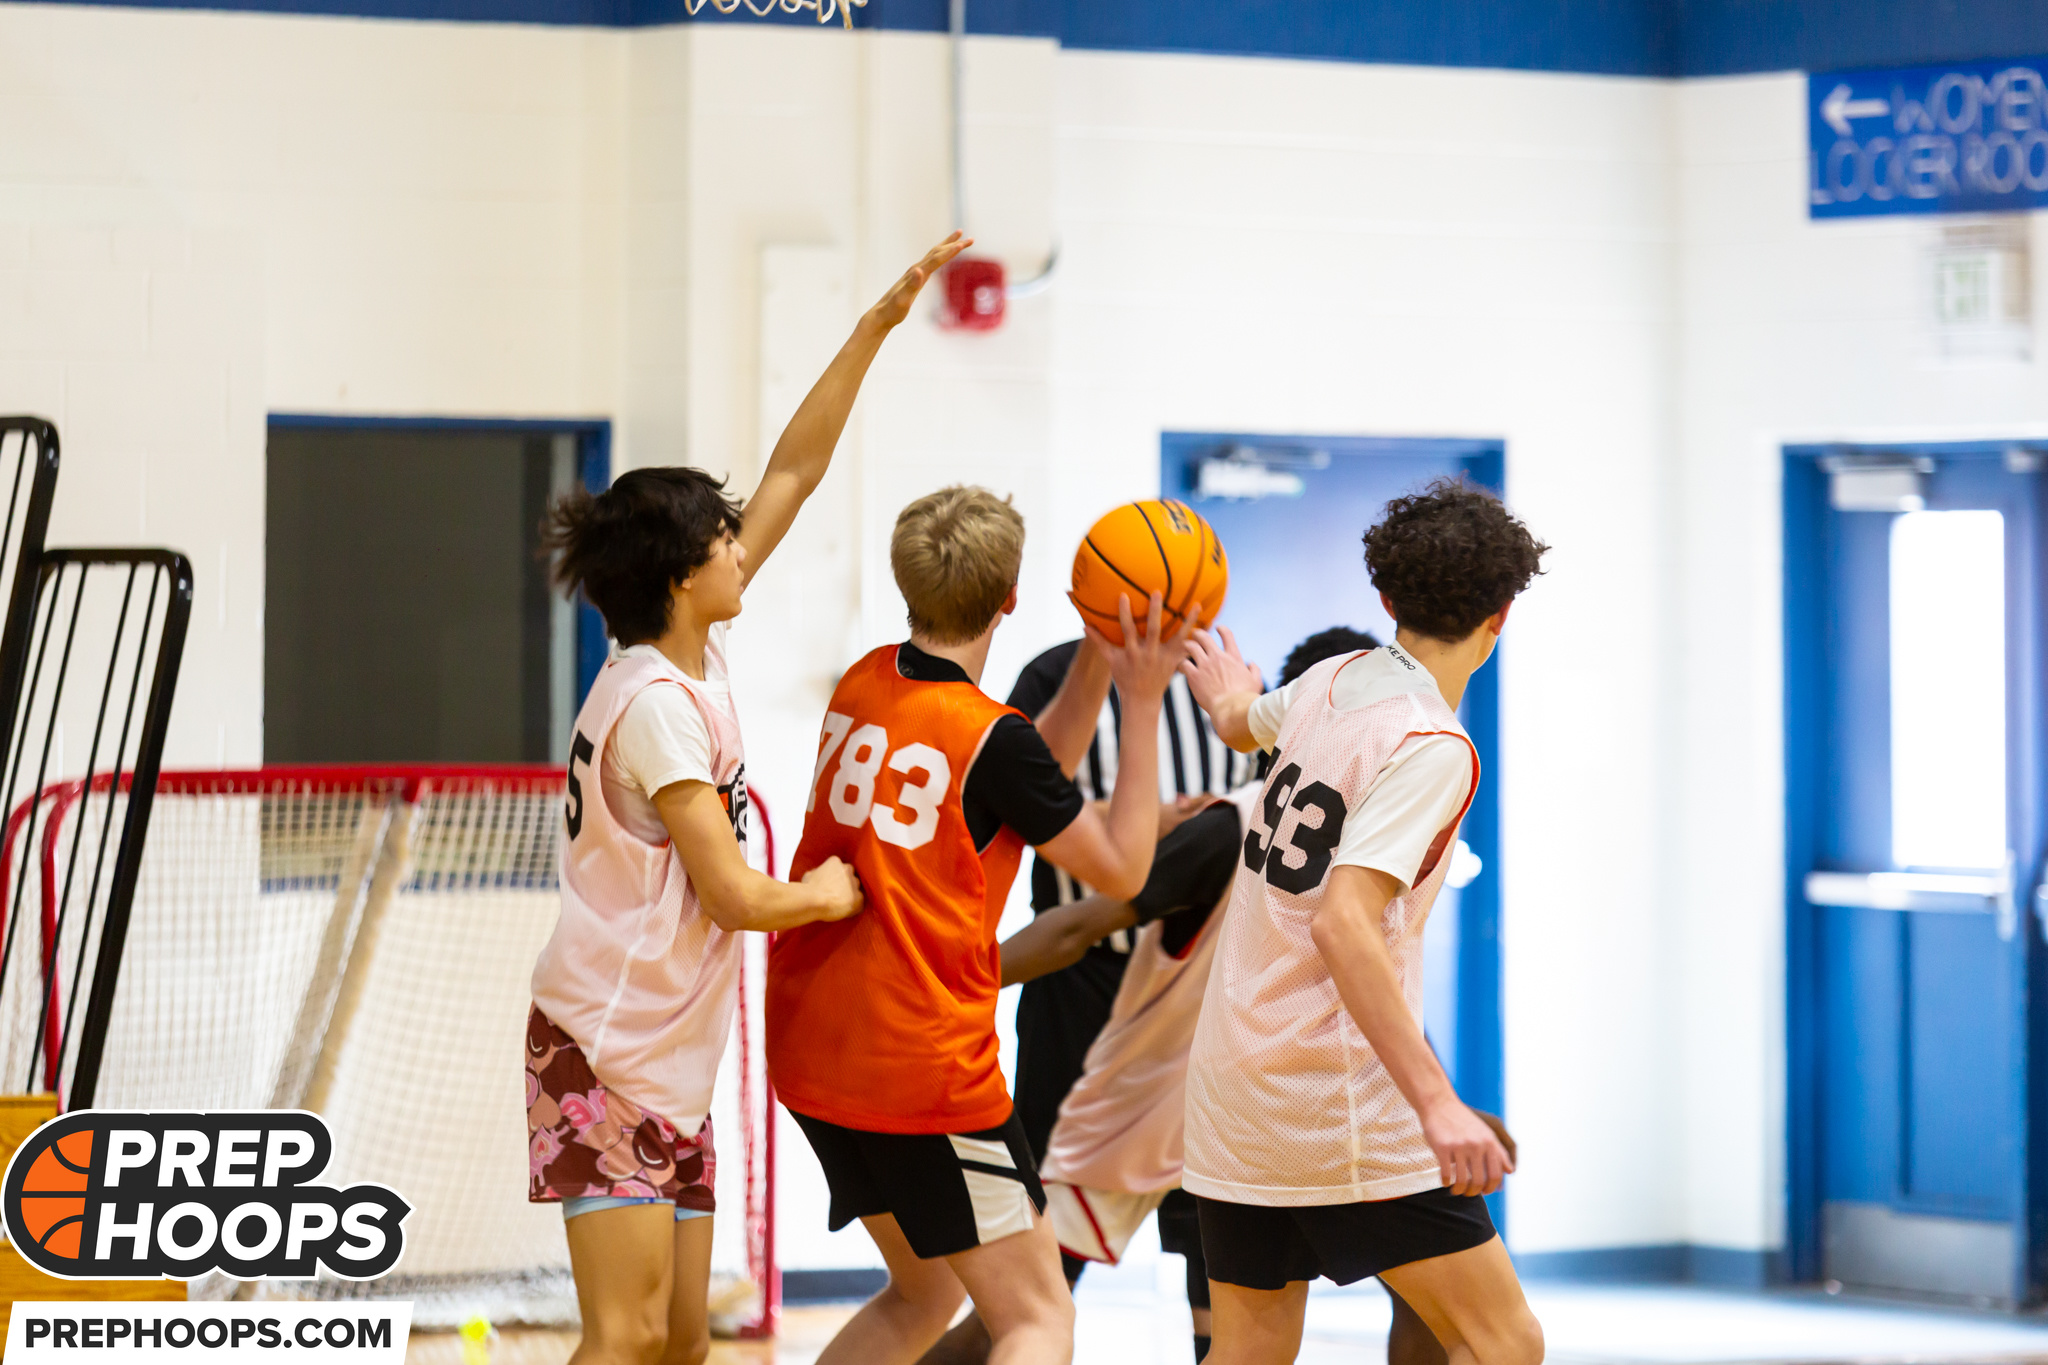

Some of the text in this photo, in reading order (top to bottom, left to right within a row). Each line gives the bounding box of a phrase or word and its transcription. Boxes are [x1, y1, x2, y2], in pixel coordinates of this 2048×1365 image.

[1889, 67, 2048, 134] WOME
[1396, 655, 1416, 671] PRO
[807, 711, 952, 850] 783
